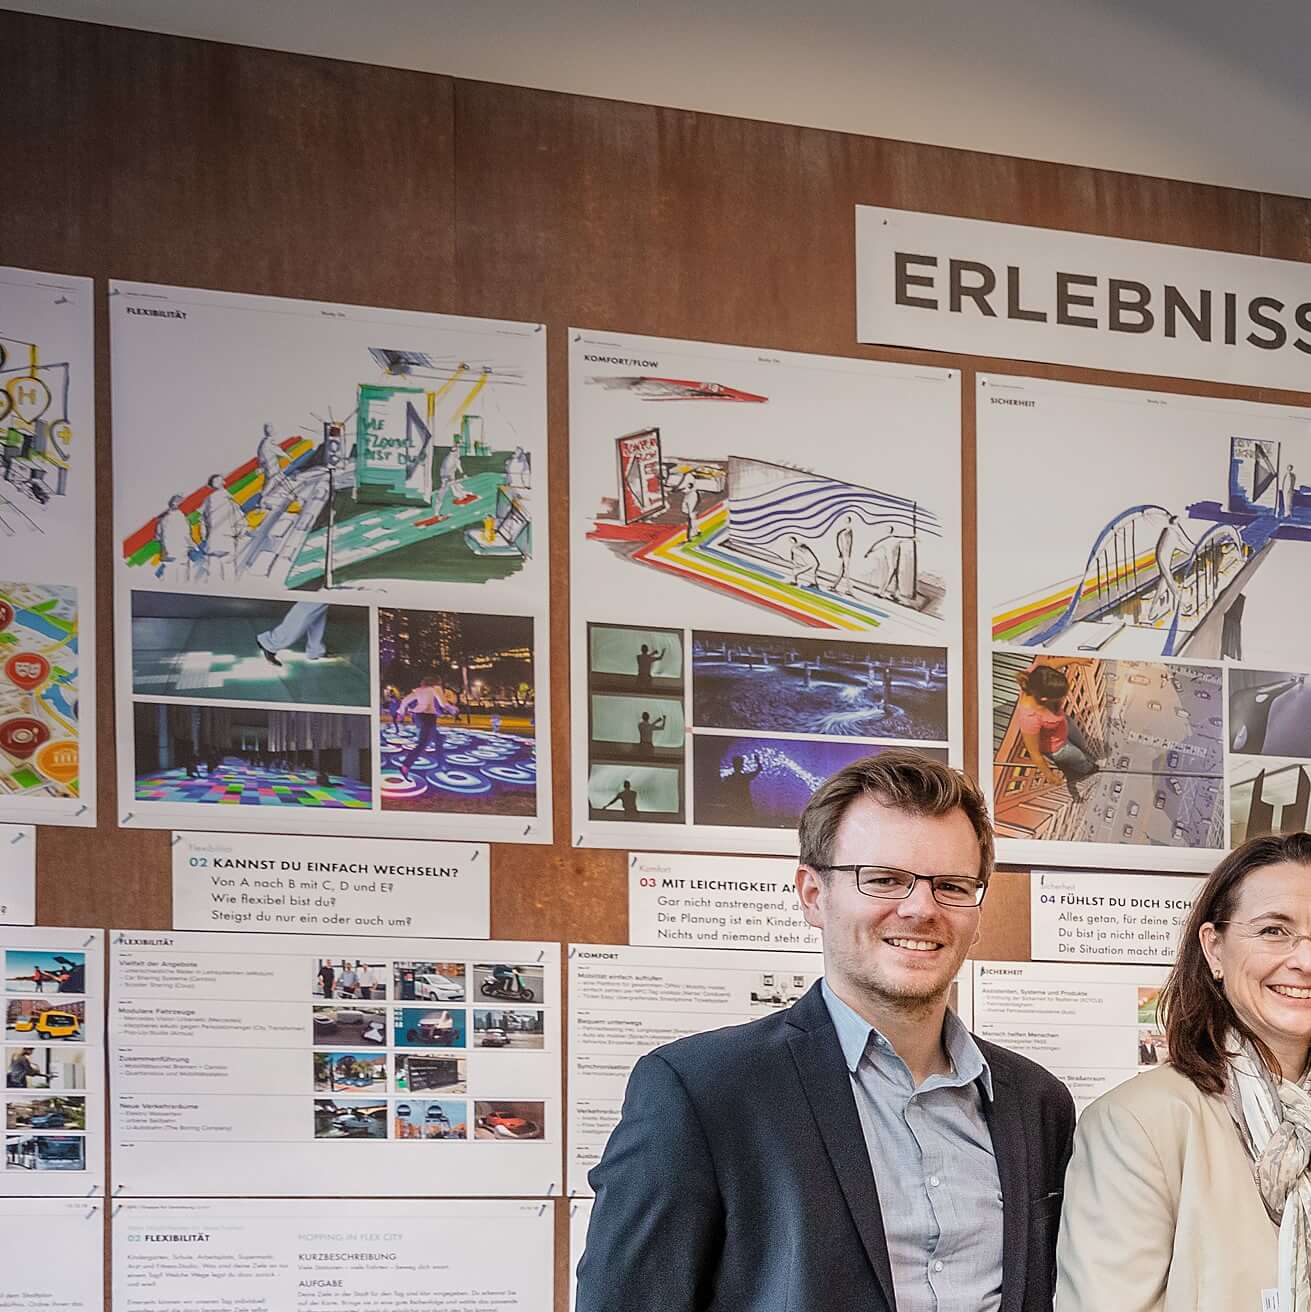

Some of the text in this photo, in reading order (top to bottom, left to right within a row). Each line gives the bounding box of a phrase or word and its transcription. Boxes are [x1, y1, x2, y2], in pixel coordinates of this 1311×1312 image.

[126, 306, 188, 320] FLEXIBILITÄT
[584, 353, 659, 369] KOMFORT/FLOW
[990, 397, 1036, 408] SICHERHEIT
[189, 857, 459, 878] 02 KANNST DU EINFACH WECHSELN?
[211, 876, 394, 893] Von A nach B mit C, D und E?
[639, 877, 777, 893] 03 MIT LEICHTIGKEIT
[211, 893, 337, 908] Wie flexibel bist du?
[657, 896, 788, 913] Gar nicht anstrengend,
[1040, 892, 1193, 910] 04 FÜHLST DU DICH SICH
[211, 910, 412, 927] Steigst du nur ein oder auch um?
[657, 912, 676, 923] Die
[681, 913, 727, 927] Planung
[730, 914, 742, 925] ist
[745, 915, 763, 926] ein
[1058, 912, 1186, 927] Alles getan, für deine Sic
[657, 929, 819, 944] Nichts und niemand steht dir
[1058, 927, 1171, 942] Du bist ja nicht allein?
[578, 952, 619, 960] KOMFORT
[1058, 943, 1175, 957] Die Situation macht dir
[145, 1232, 210, 1243] FLEXIBILITÄT
[298, 1252, 397, 1262] KURZBESCHREIBUNG
[298, 1279, 343, 1289] AUFGABE
